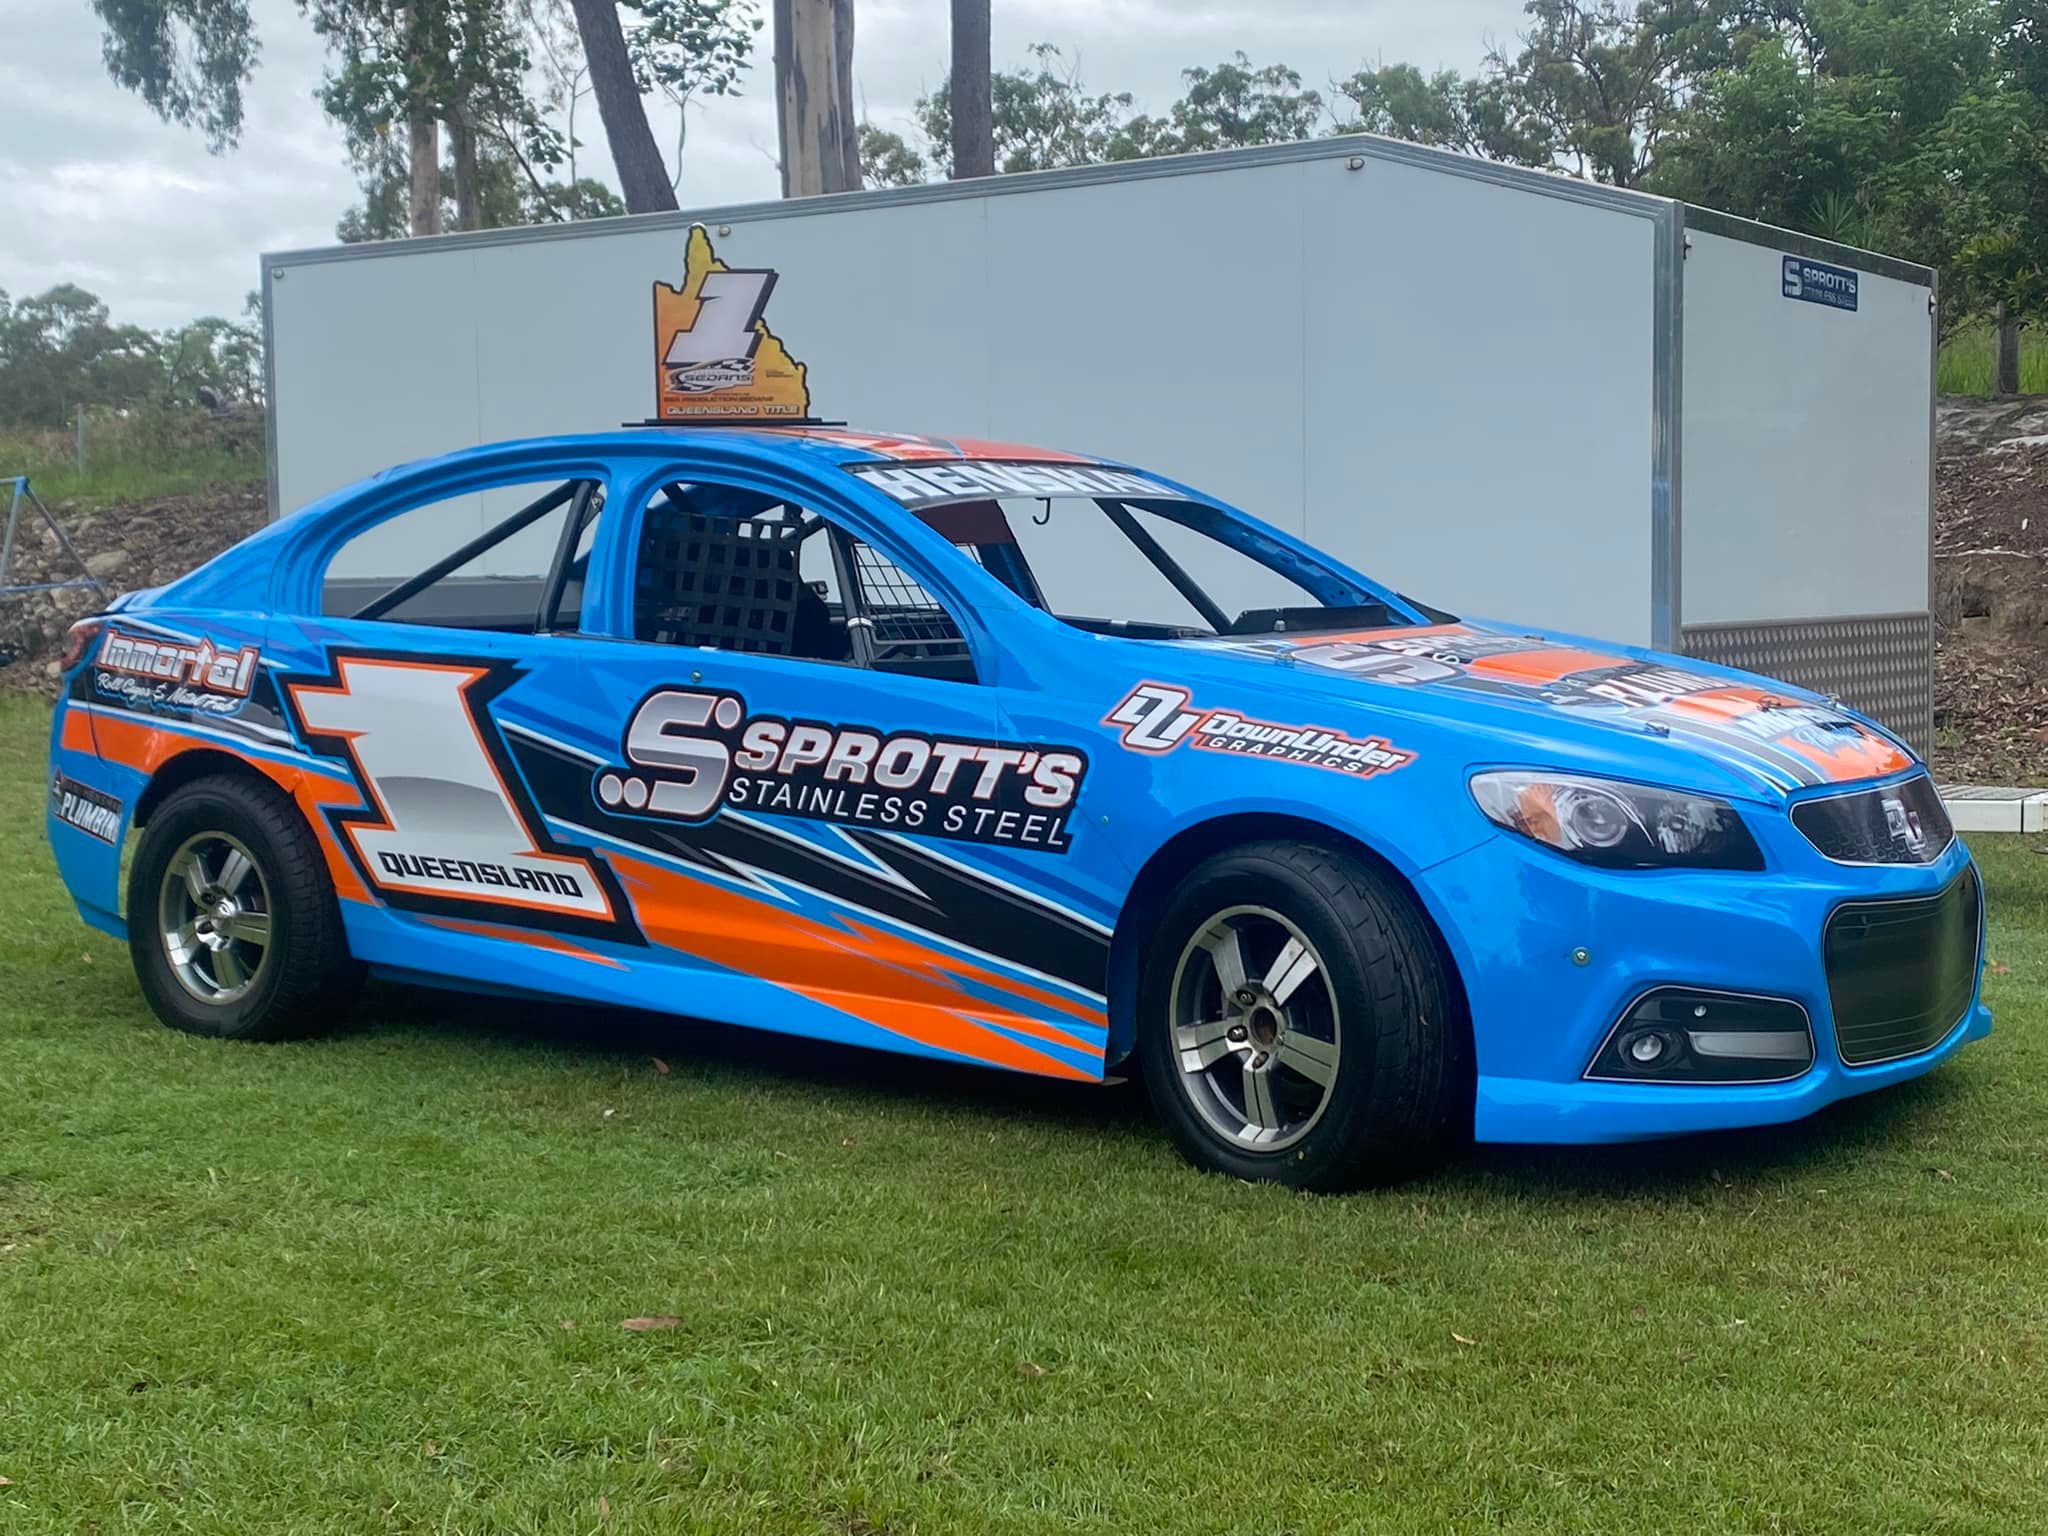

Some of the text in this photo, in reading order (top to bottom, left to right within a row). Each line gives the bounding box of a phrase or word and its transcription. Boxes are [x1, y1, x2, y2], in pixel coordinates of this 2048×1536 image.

[1803, 267, 1857, 293] SPROTT'S
[664, 269, 775, 366] 1
[684, 374, 751, 382] SEDANS
[667, 405, 800, 415] QUEENSLAND TITLE
[100, 632, 255, 692] Immortal
[735, 720, 1083, 808] SPROTT'S
[1208, 736, 1363, 773] GRAPHICS
[290, 658, 613, 917] 1
[728, 777, 1065, 846] STAINLESS STEEL
[377, 850, 584, 898] QUEENSLAND
